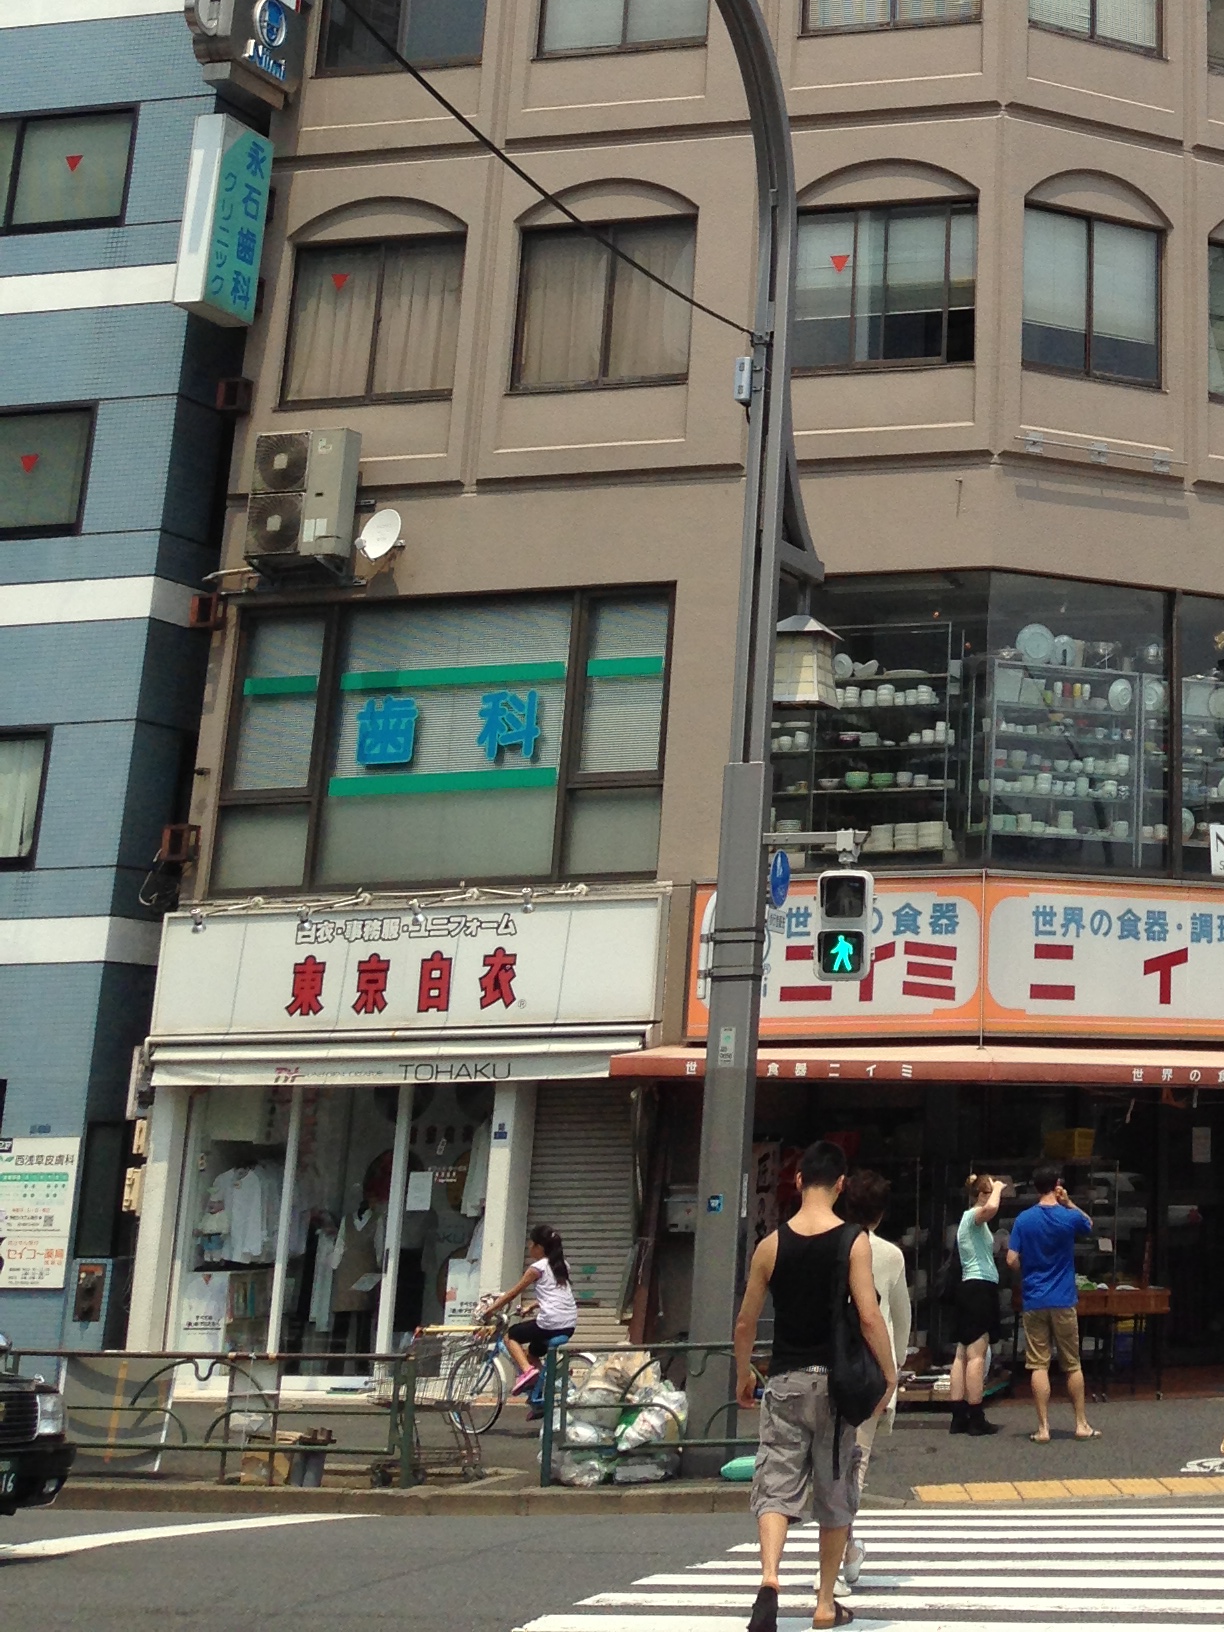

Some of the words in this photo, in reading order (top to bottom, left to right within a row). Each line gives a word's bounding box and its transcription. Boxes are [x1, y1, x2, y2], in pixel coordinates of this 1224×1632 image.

[245, 39, 287, 81] Niimi
[230, 140, 267, 310] 永石歯科
[356, 689, 541, 765] 歯科
[786, 902, 959, 938] 世食器
[285, 946, 518, 1017] 東京白衣
[399, 1062, 512, 1081] TOHAKU
